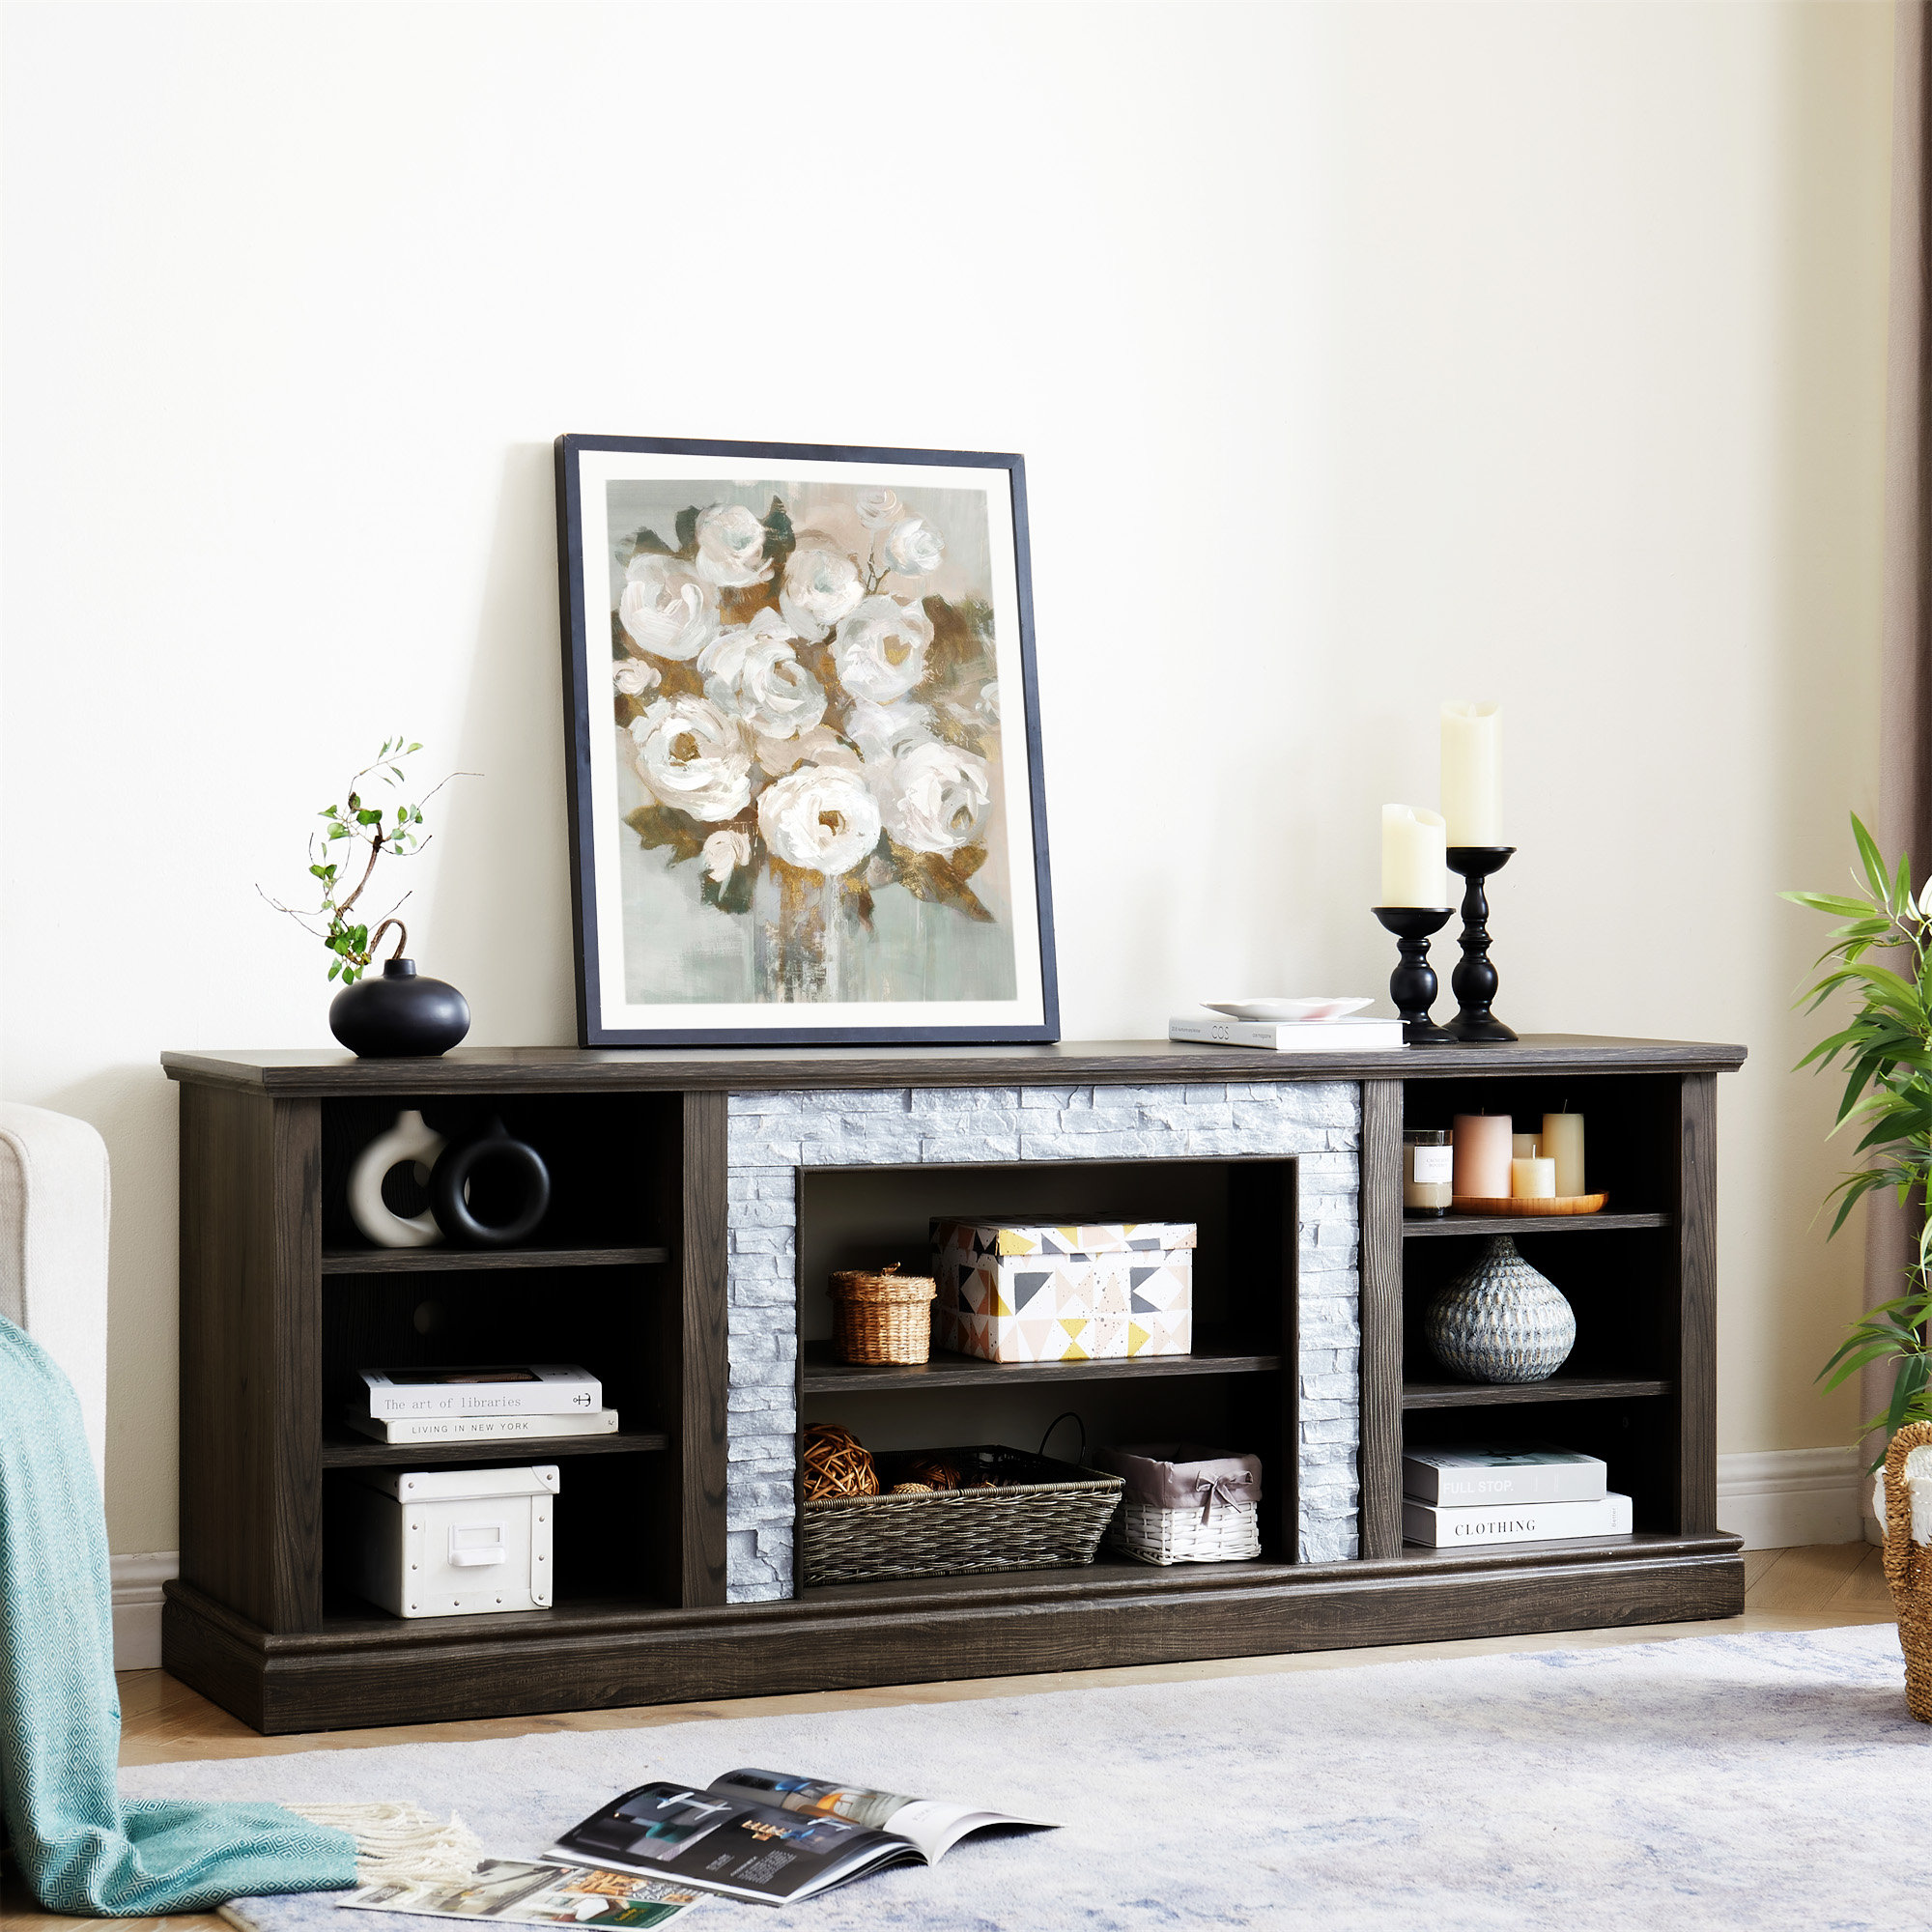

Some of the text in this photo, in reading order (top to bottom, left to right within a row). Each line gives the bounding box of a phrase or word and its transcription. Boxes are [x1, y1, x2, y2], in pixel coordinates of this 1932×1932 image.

[1212, 1025, 1229, 1040] COS
[384, 1396, 522, 1410] The art of libraries
[412, 1426, 448, 1435] LIVING
[471, 1423, 494, 1432] NEW
[500, 1422, 528, 1431] YORK
[1443, 1479, 1514, 1494] FULL STOP.
[1455, 1520, 1537, 1537] CLOTHING
